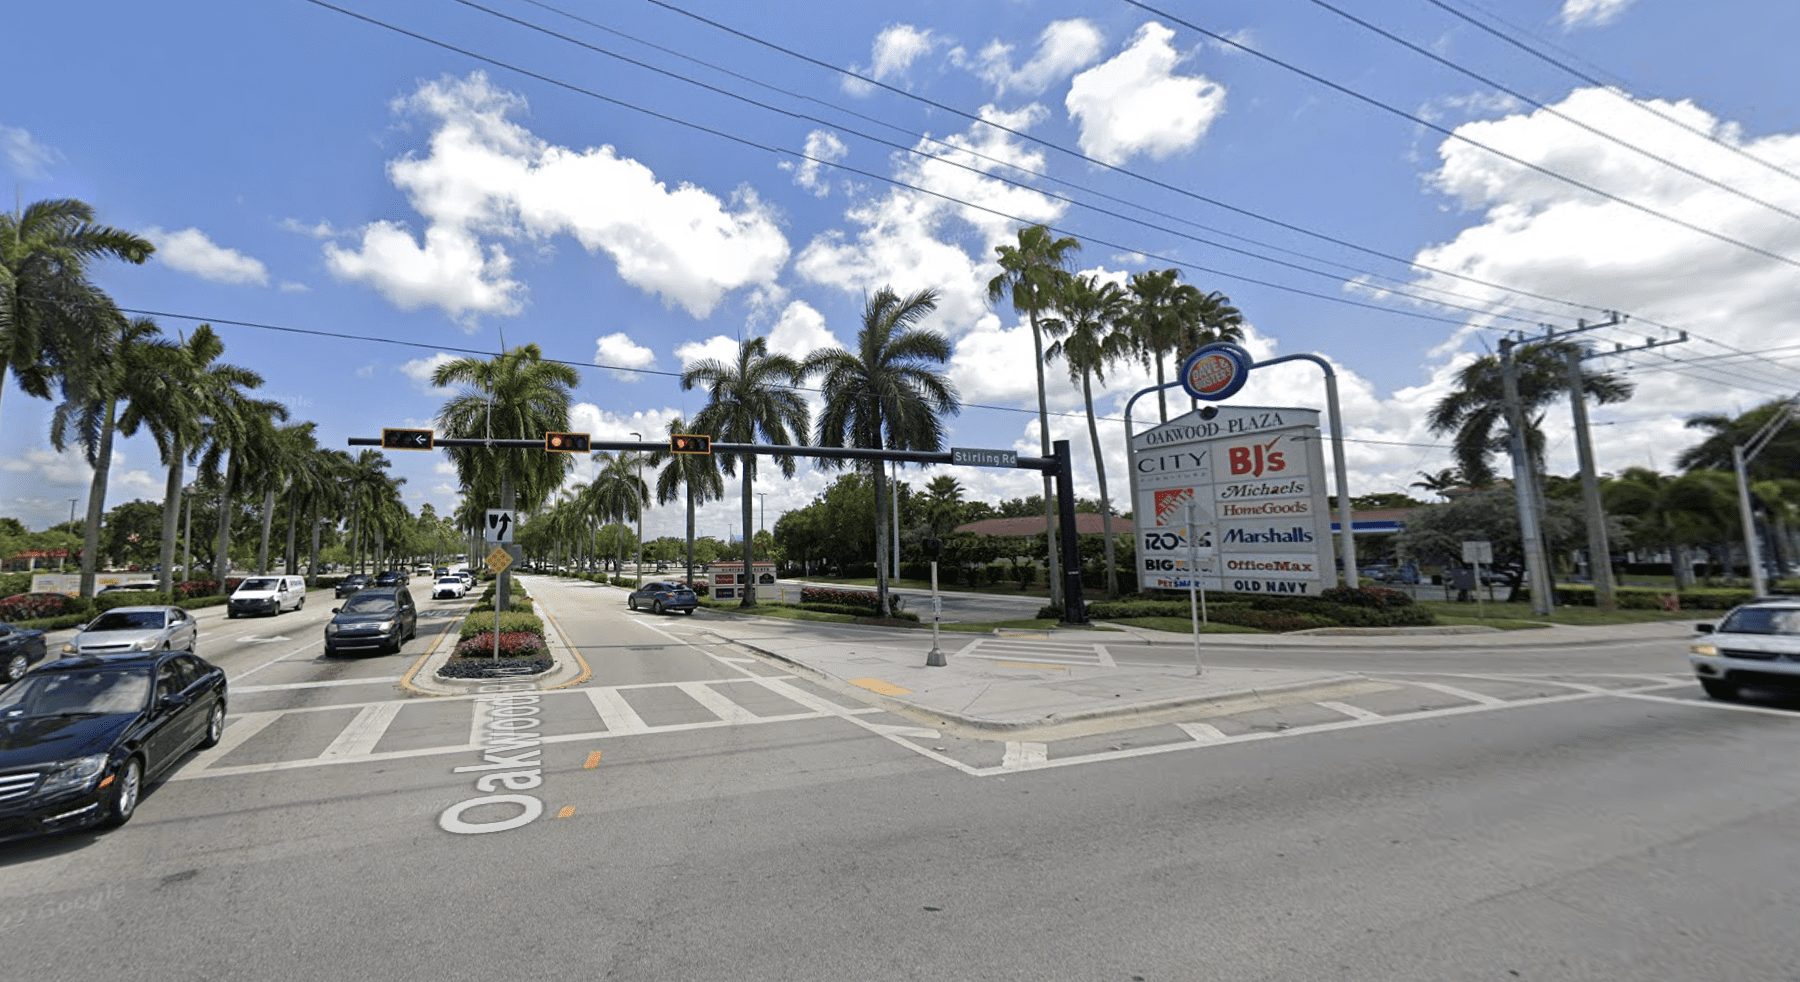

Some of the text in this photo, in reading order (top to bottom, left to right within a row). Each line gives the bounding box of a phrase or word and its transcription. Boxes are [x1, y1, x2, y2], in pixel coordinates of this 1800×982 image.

[1146, 412, 1284, 445] OAKWOOD PLAZA
[955, 451, 1016, 466] Stirling Rd
[1138, 450, 1206, 473] CITY
[1221, 481, 1305, 499] Michaels
[1223, 501, 1308, 516] HomeGoods
[1223, 527, 1314, 543] Marshalls
[1145, 559, 1174, 571] BIG
[1227, 560, 1313, 572] OfficeMax
[1234, 580, 1307, 593] OLD NAVY
